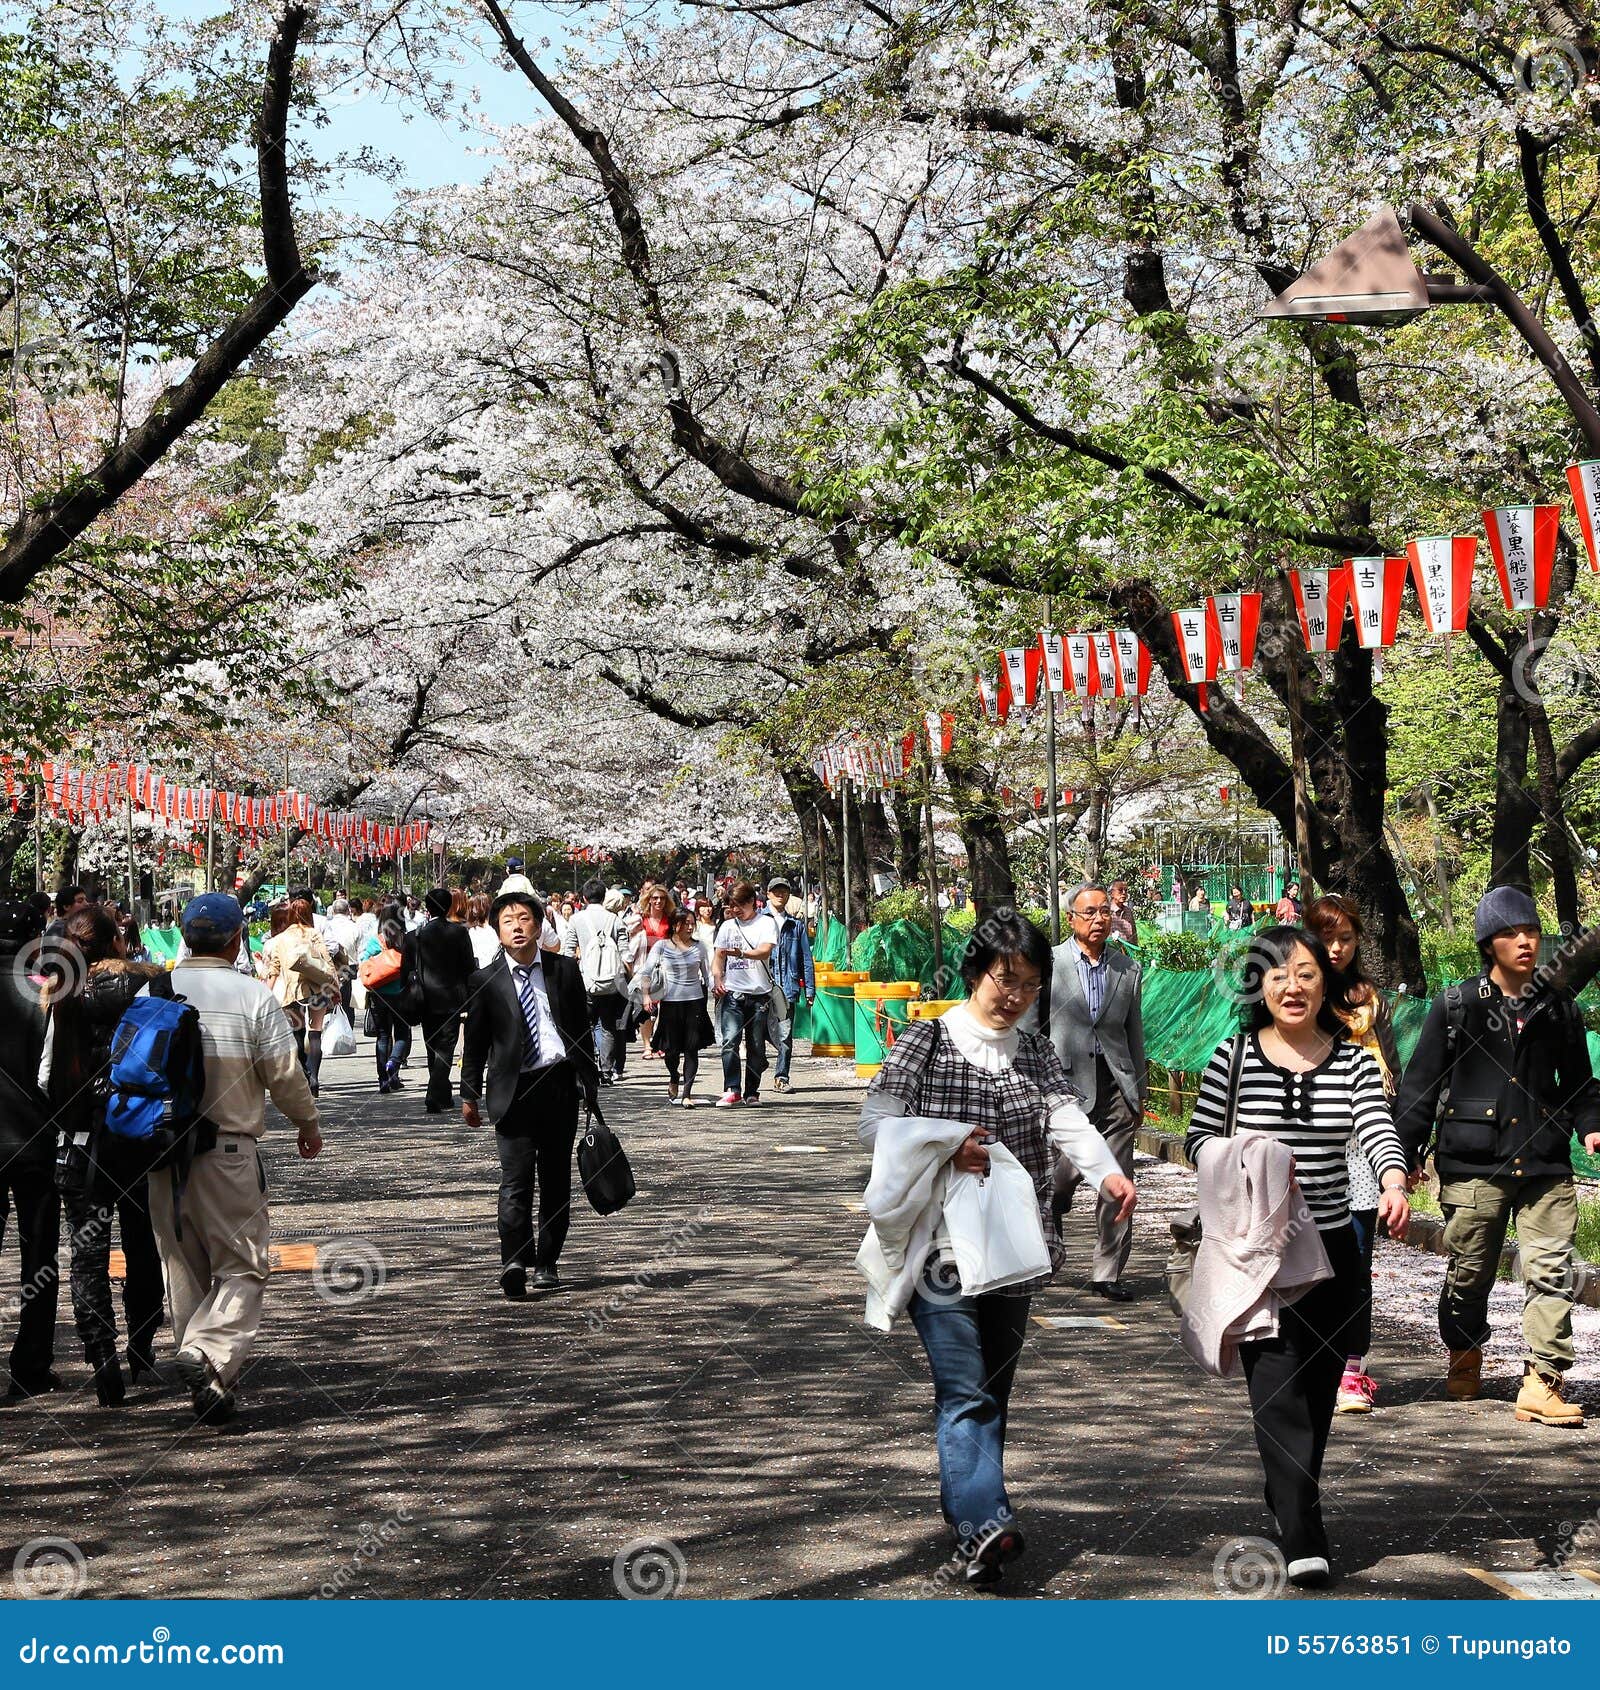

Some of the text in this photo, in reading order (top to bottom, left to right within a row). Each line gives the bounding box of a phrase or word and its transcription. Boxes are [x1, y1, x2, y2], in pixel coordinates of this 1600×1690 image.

[1506, 510, 1529, 600] 洋食黒船亭
[1304, 579, 1325, 637] 吉池
[1359, 568, 1379, 629] 吉池
[1184, 618, 1204, 669] 吉池
[1219, 603, 1239, 656] 吉池
[1007, 654, 1024, 697] 吉池
[1046, 639, 1061, 681] 吉池
[1072, 641, 1087, 688] 吉池
[1097, 641, 1114, 689] 吉池
[1119, 638, 1137, 684] 吉池
